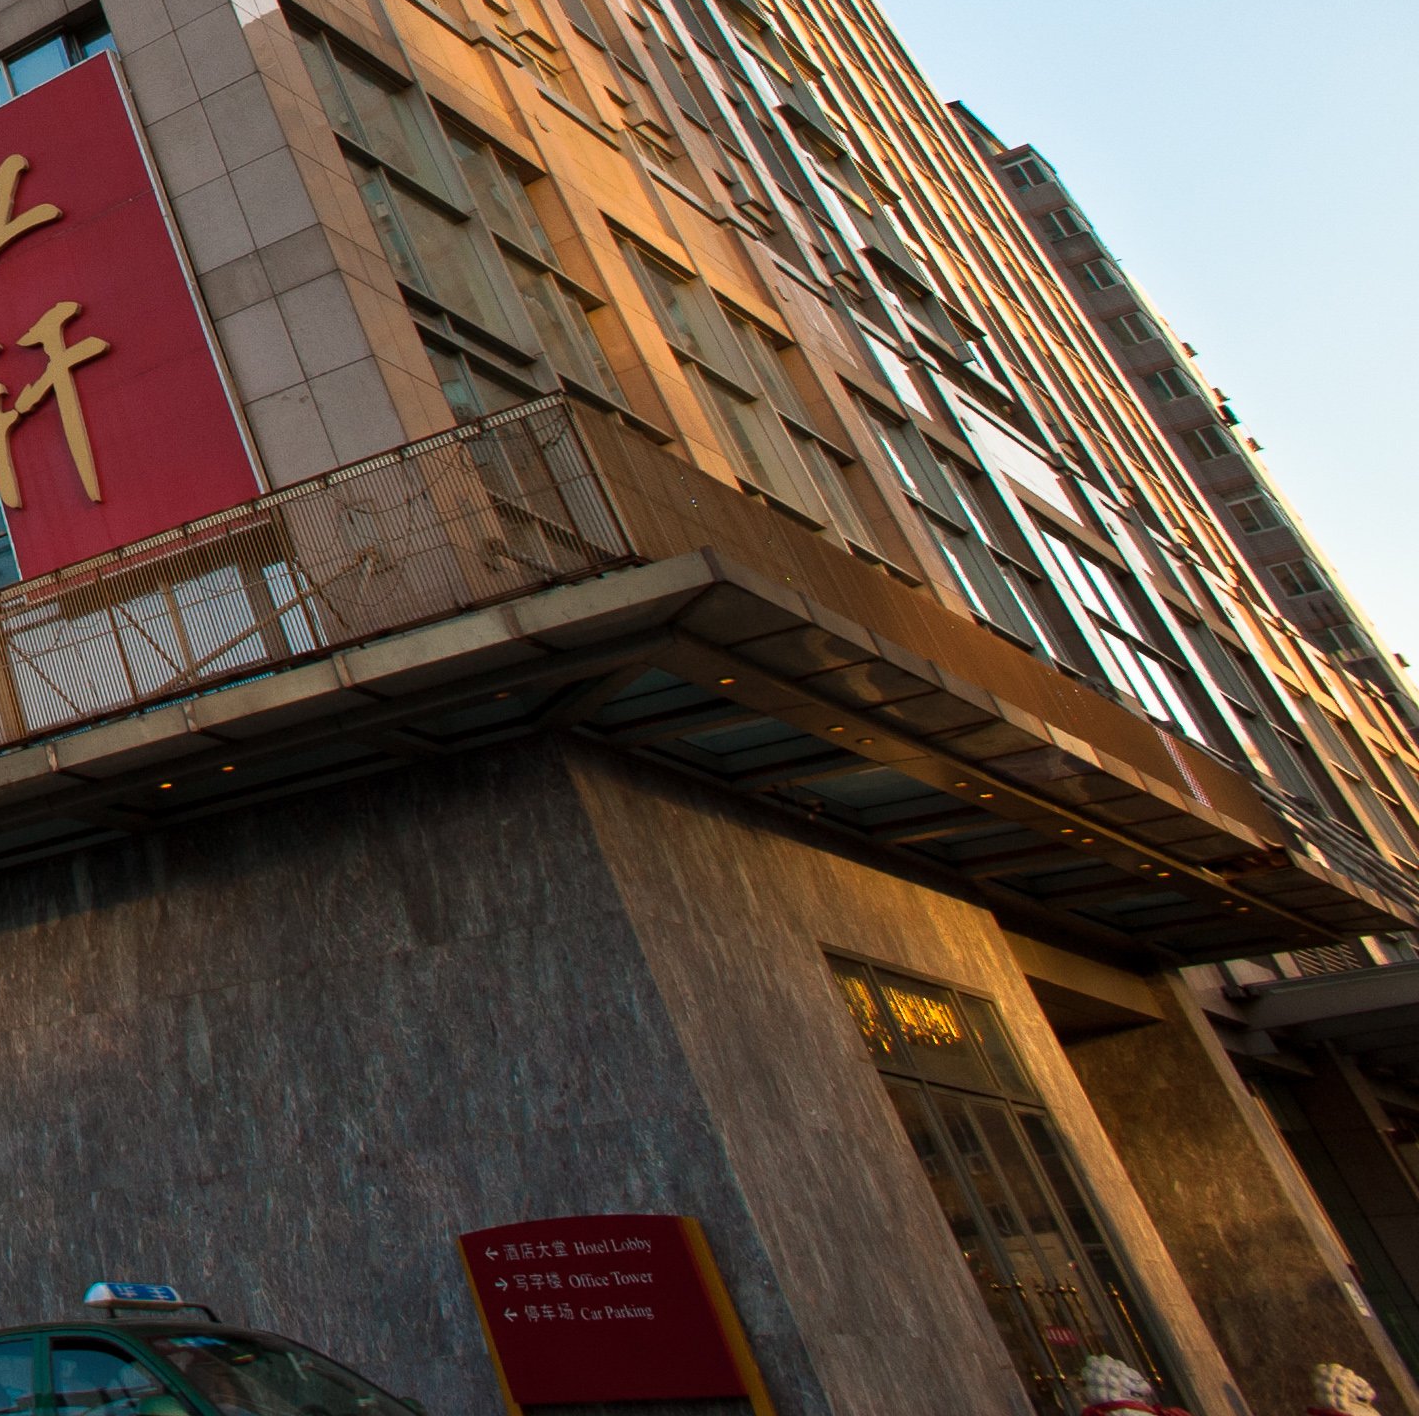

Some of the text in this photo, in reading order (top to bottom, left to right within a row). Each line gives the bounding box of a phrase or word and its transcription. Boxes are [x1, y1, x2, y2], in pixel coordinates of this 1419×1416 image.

[502, 1235, 652, 1261] 酒店大堂 Hotel Lobby
[513, 1270, 653, 1291] 写字楼 Office Tower
[524, 1302, 655, 1322] 停车场 Car Parking
